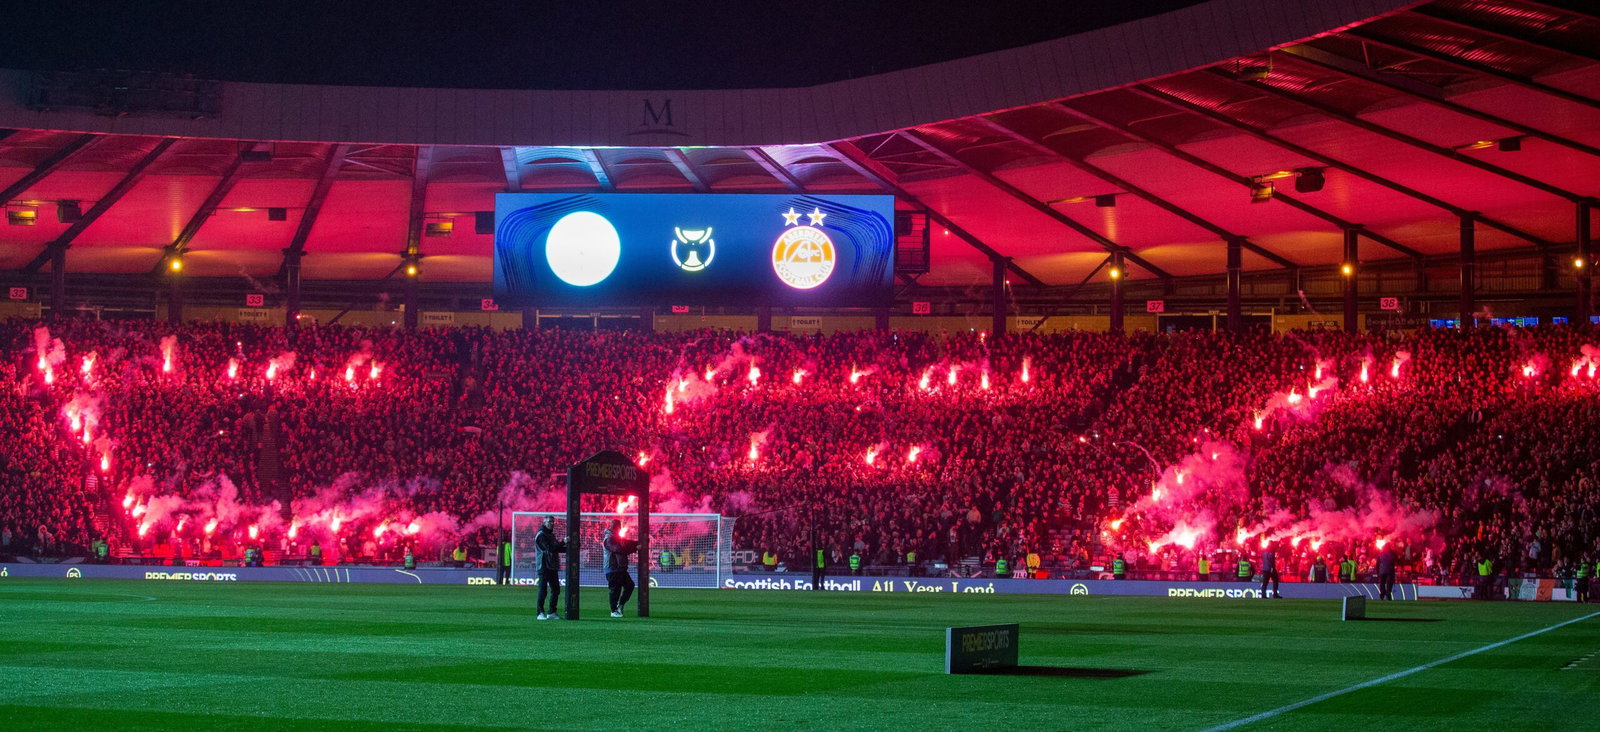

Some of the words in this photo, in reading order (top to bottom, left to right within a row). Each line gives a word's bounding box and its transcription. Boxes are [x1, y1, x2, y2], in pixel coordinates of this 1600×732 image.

[640, 98, 674, 127] M
[11, 288, 25, 298] 32
[248, 295, 262, 305] 33
[1381, 299, 1395, 308] 38
[914, 303, 929, 312] 36
[1149, 302, 1162, 311] 37
[725, 578, 791, 590] Scottish
[872, 580, 894, 592] All
[904, 581, 943, 593] Year
